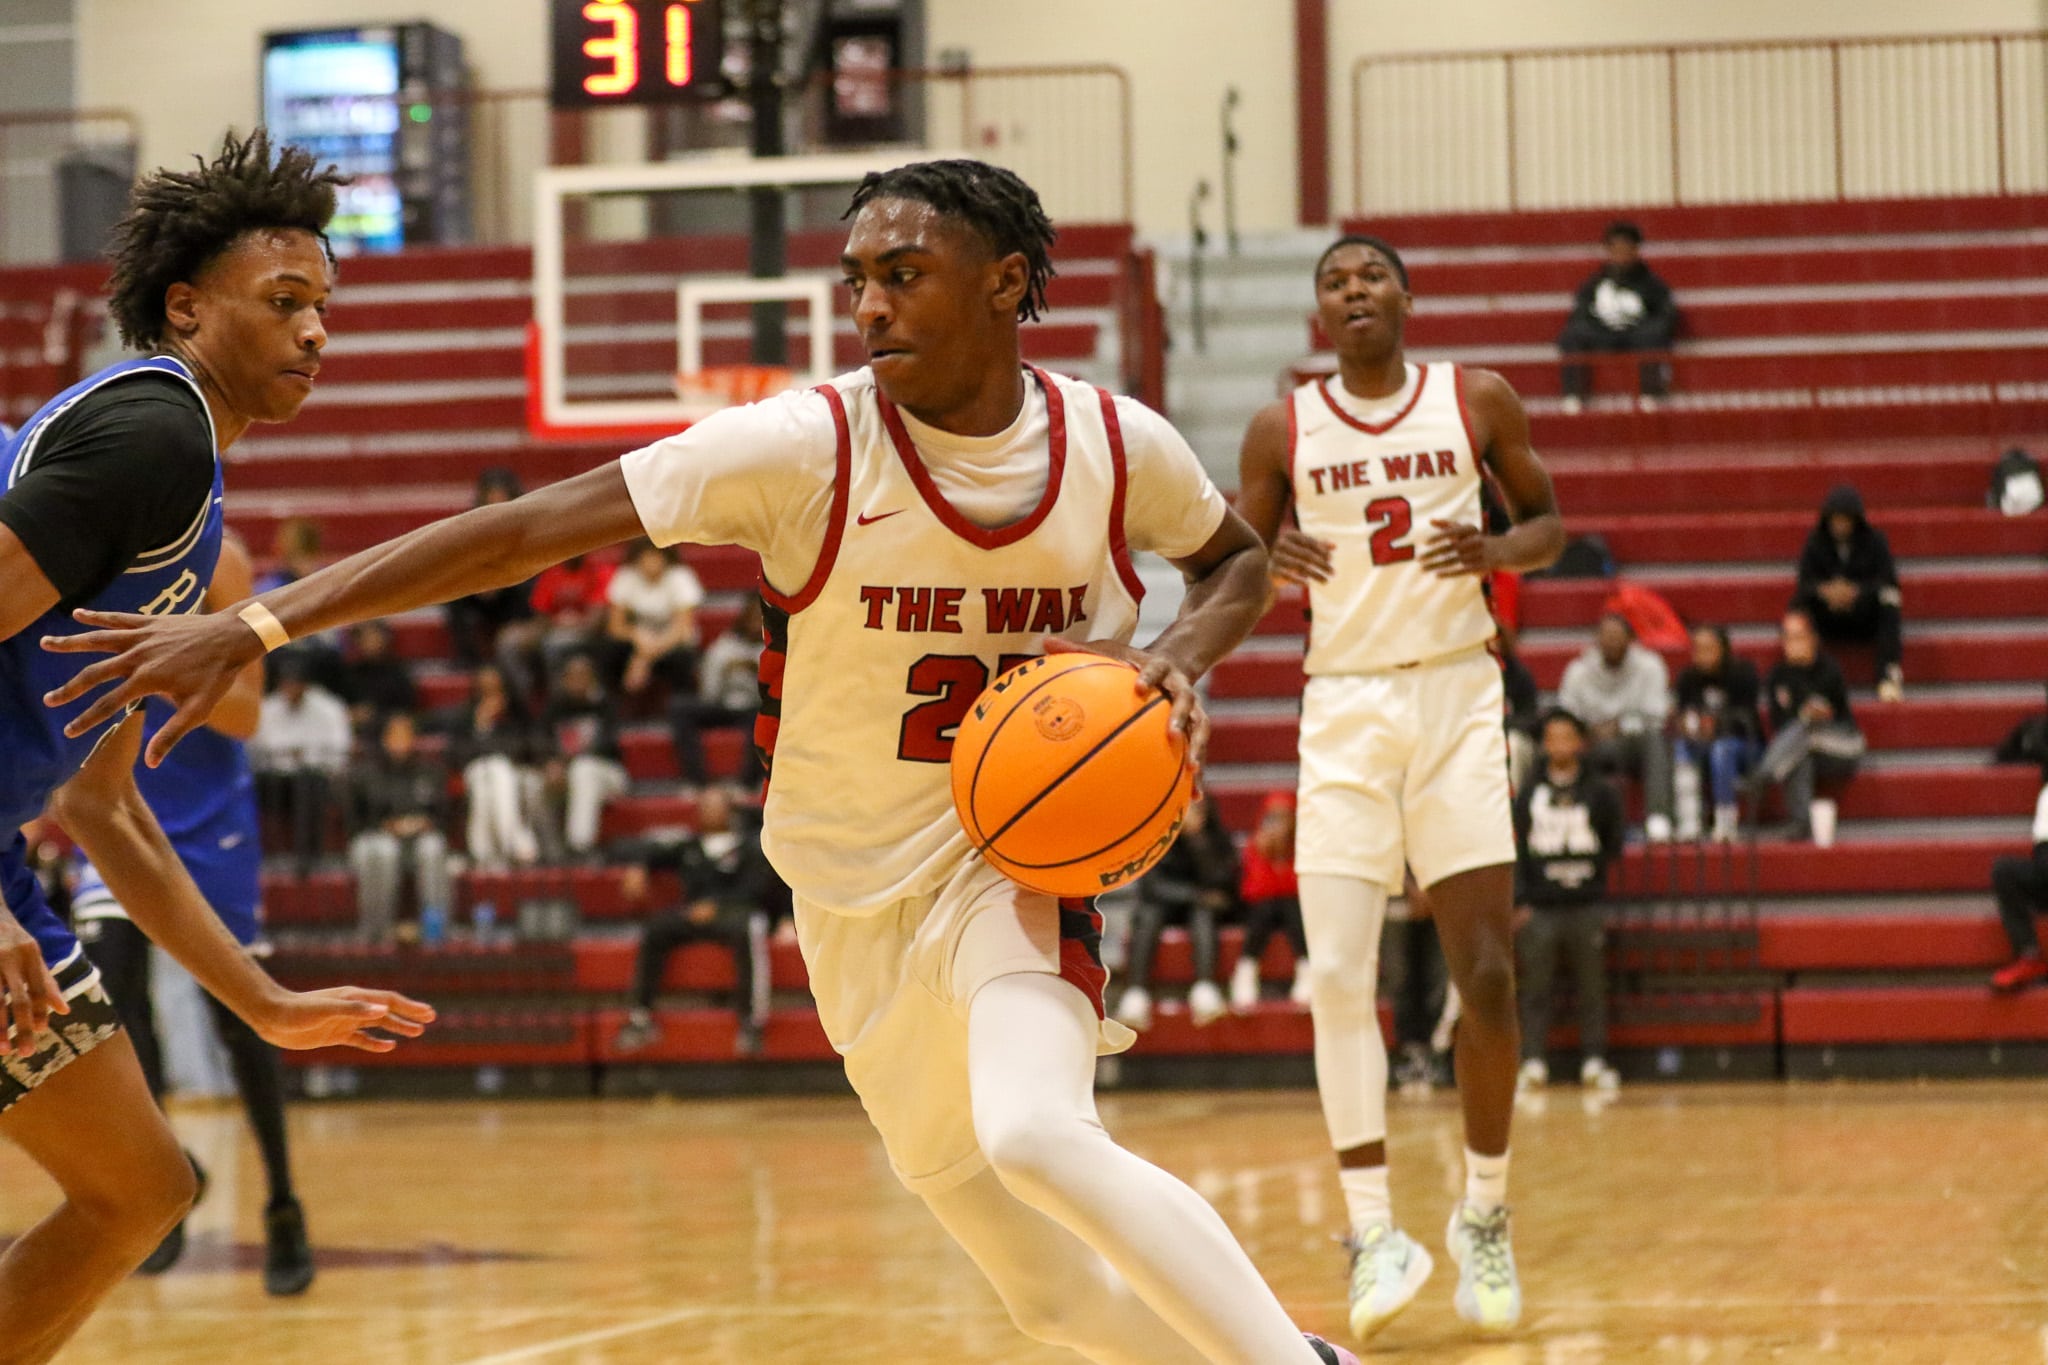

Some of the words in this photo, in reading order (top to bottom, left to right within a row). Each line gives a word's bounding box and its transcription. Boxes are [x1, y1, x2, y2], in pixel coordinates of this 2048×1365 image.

[582, 2, 691, 95] 31
[1309, 460, 1370, 495] THE
[1381, 450, 1457, 482] WAR
[1365, 496, 1415, 566] 2
[860, 585, 966, 634] THE
[897, 653, 1047, 764] 2
